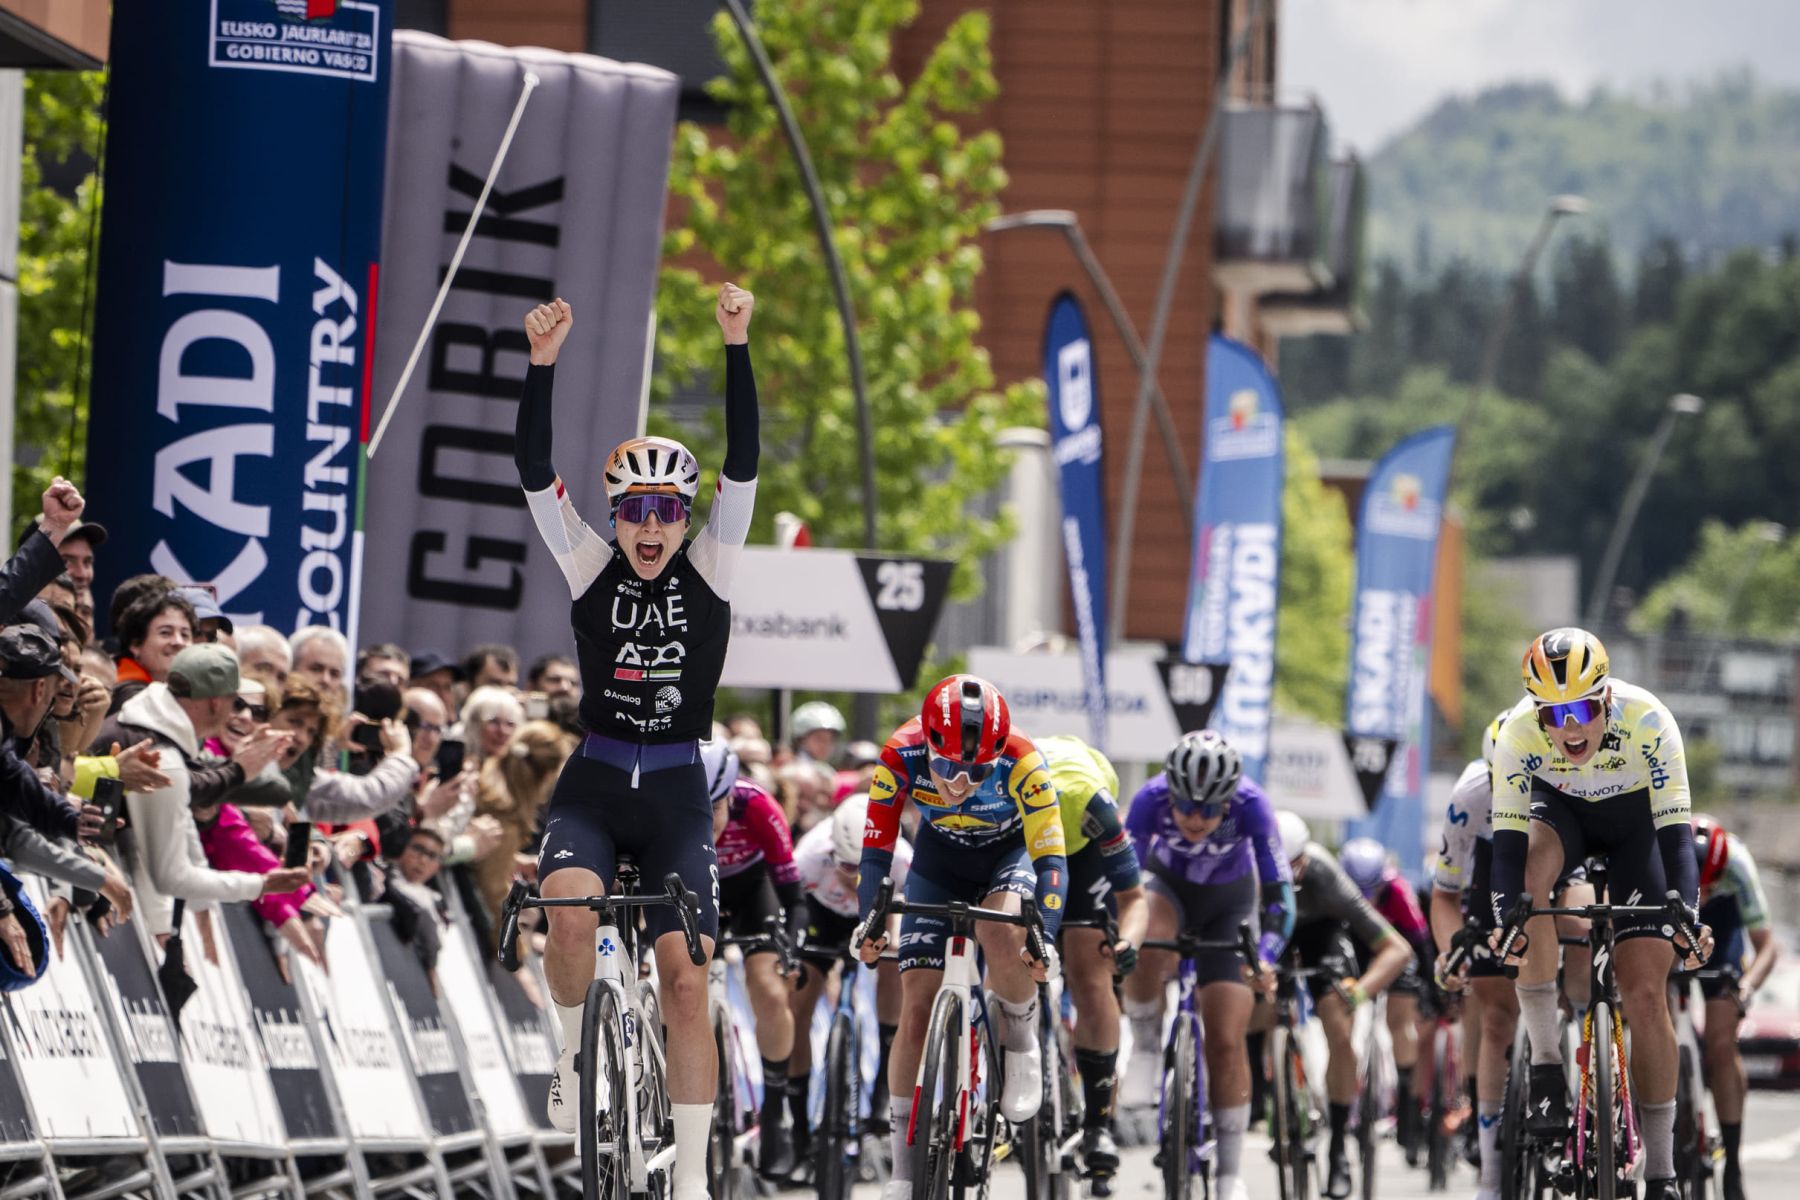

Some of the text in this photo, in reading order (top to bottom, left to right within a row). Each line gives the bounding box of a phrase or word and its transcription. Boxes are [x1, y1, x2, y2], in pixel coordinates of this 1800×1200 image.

[221, 21, 372, 48] EUSKO JAURLARITZA
[226, 44, 368, 71] GOBIERNO VASCO
[406, 161, 566, 611] GOBIK
[875, 561, 925, 612] 25
[611, 594, 688, 630] UAE
[612, 625, 688, 637] TEAM
[611, 691, 641, 706] Analog
[655, 700, 669, 709] IHC
[941, 685, 951, 727] TREK
